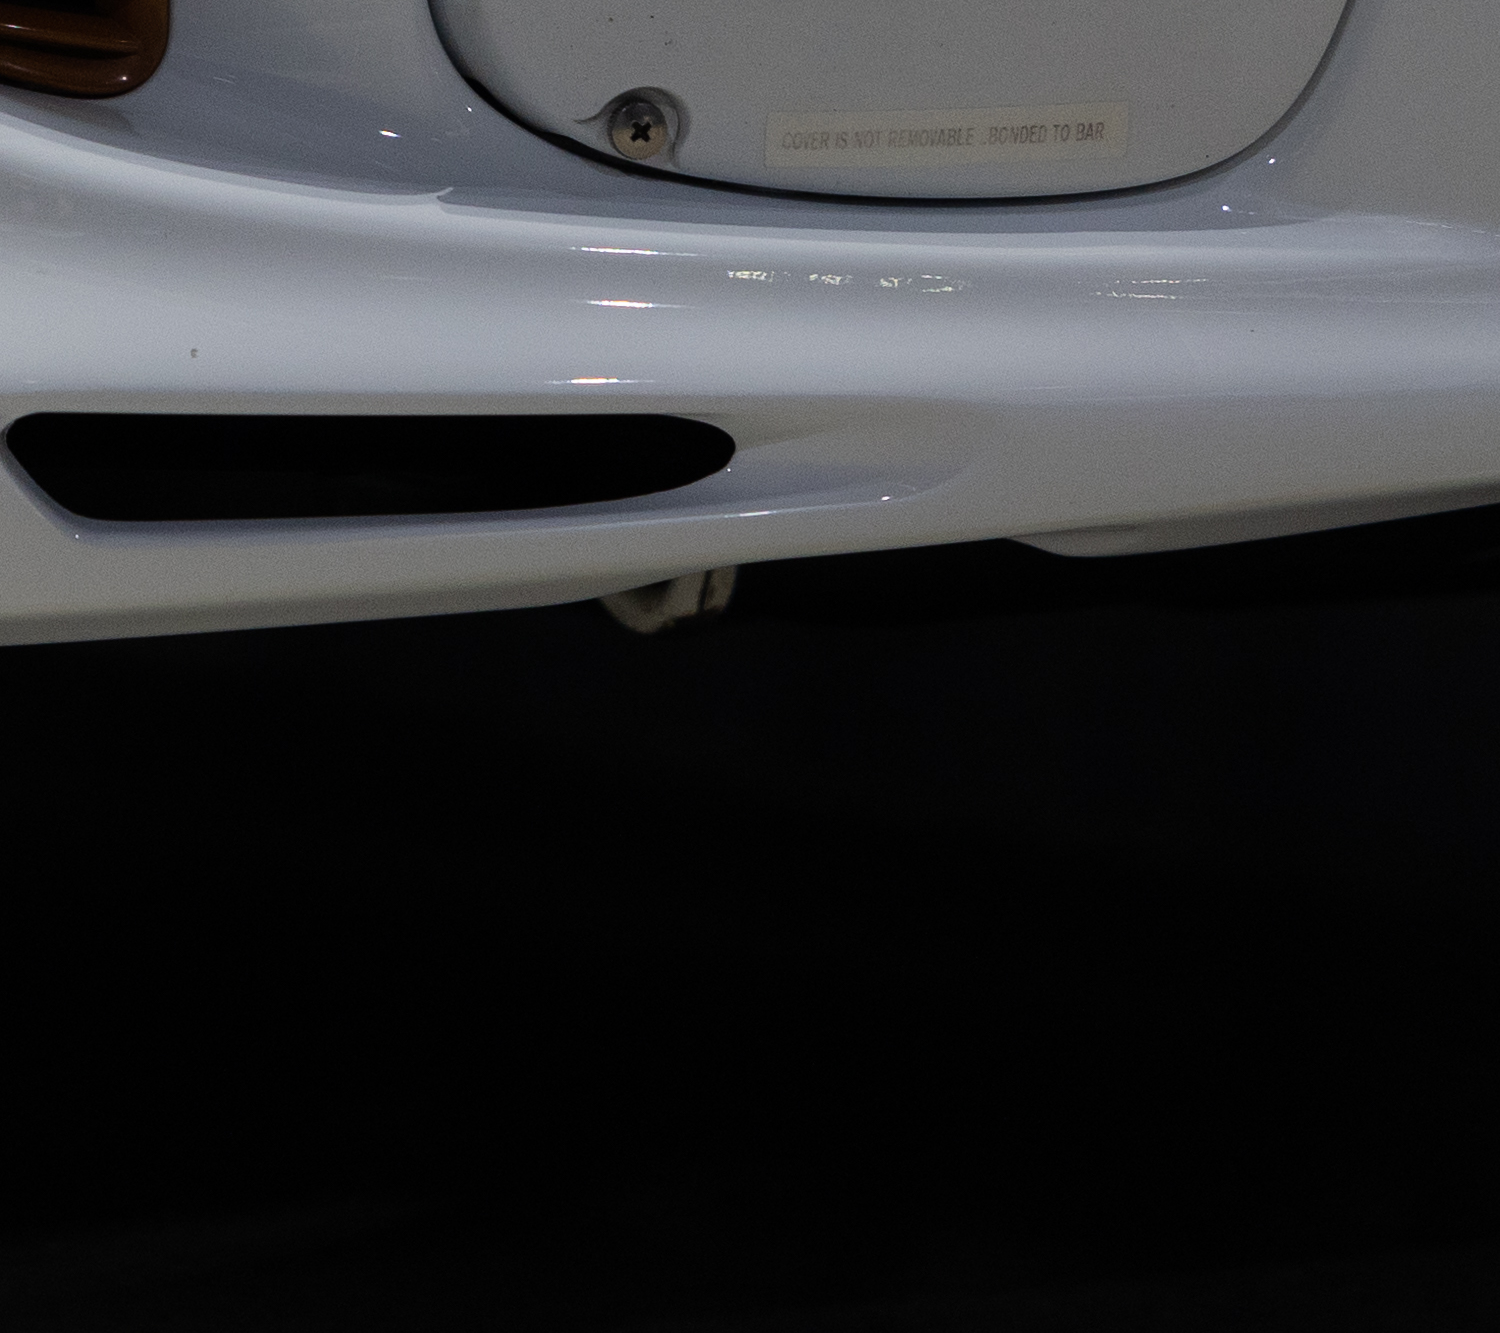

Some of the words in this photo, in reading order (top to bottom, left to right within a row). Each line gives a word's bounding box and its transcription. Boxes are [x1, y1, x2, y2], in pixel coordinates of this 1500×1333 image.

[781, 131, 831, 151] COVER
[834, 130, 850, 150] IS
[852, 129, 882, 149] NOT
[887, 126, 975, 149] REMOVABLE
[1052, 124, 1073, 143] TO
[1075, 121, 1106, 143] BAR
